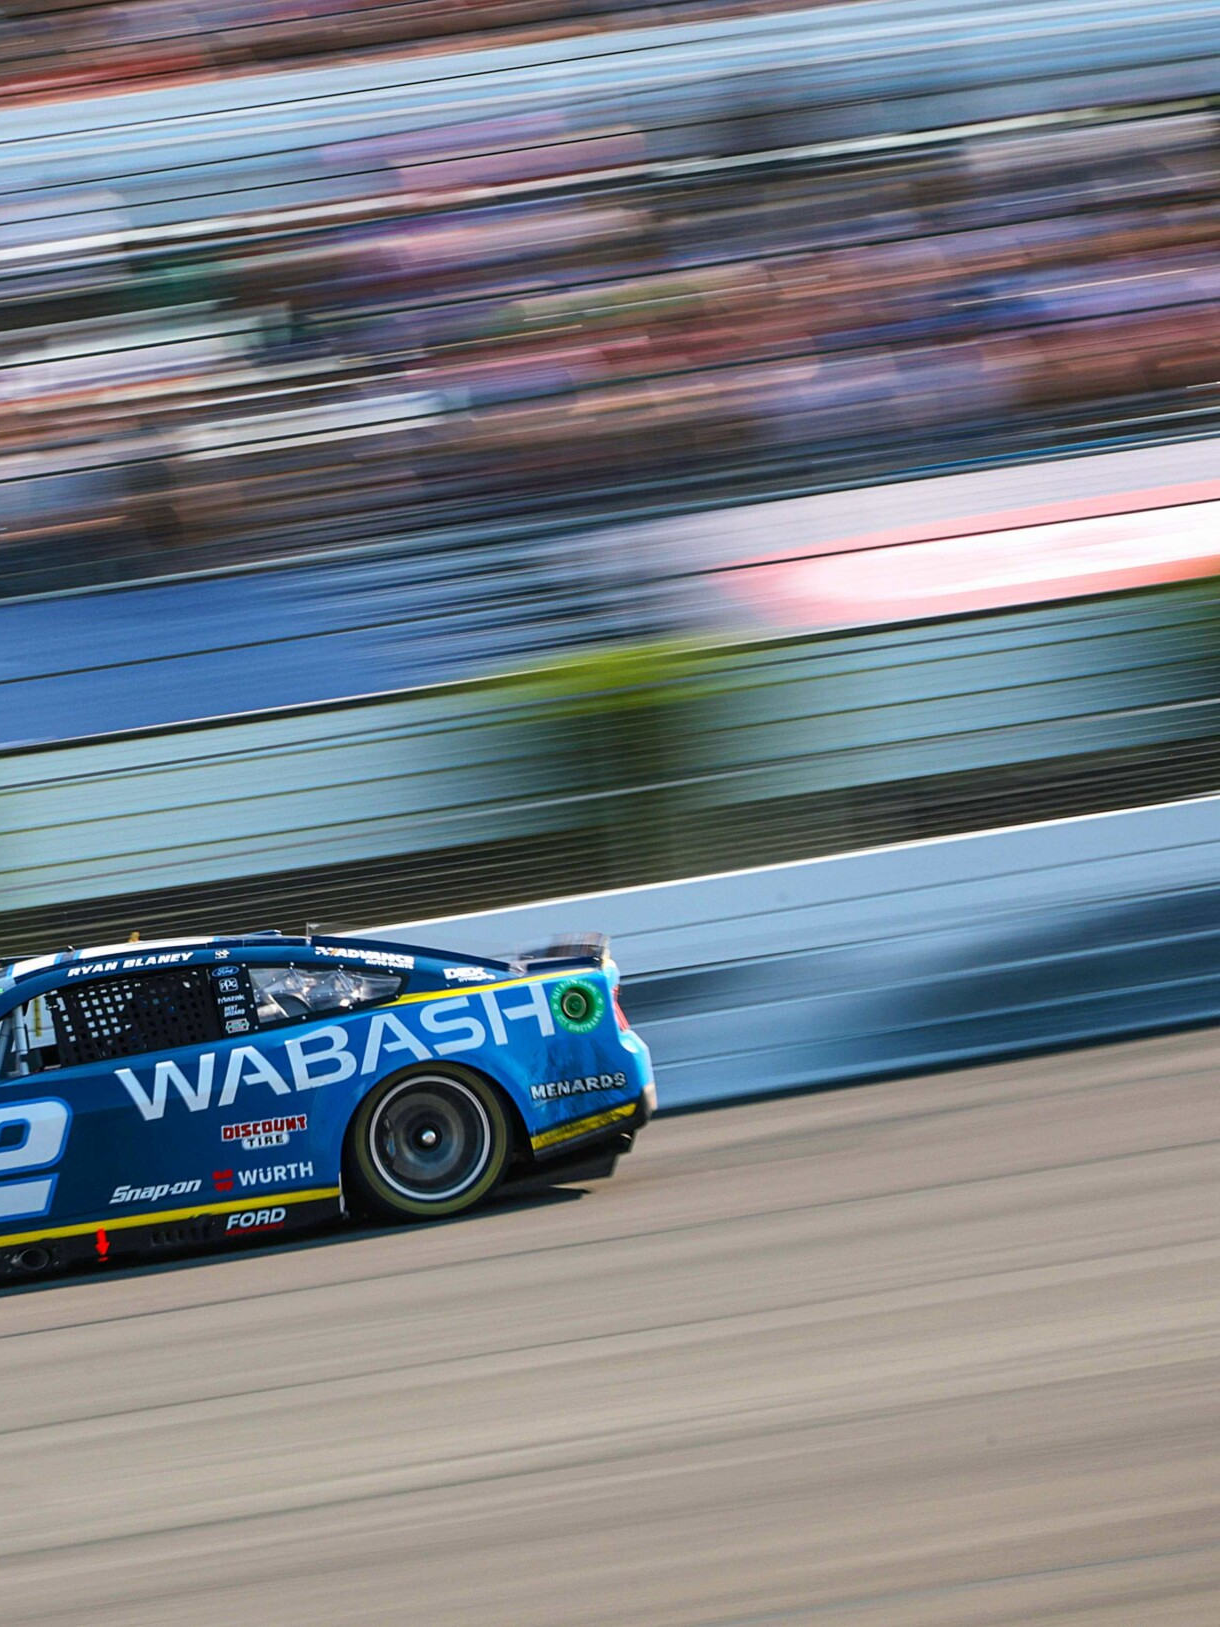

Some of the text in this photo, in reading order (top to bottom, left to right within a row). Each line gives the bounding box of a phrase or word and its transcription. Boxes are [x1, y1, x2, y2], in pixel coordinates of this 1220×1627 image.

[67, 952, 194, 977] RYAN BLANEY
[334, 947, 415, 965] ADVANCE
[114, 981, 556, 1121] WABASH
[530, 1072, 626, 1100] MENARDS
[221, 1113, 307, 1141] DISCOUNT
[247, 1133, 284, 1148] TIRE
[108, 1161, 314, 1204] Snap-on WÜRTH
[226, 1207, 286, 1231] FORD
